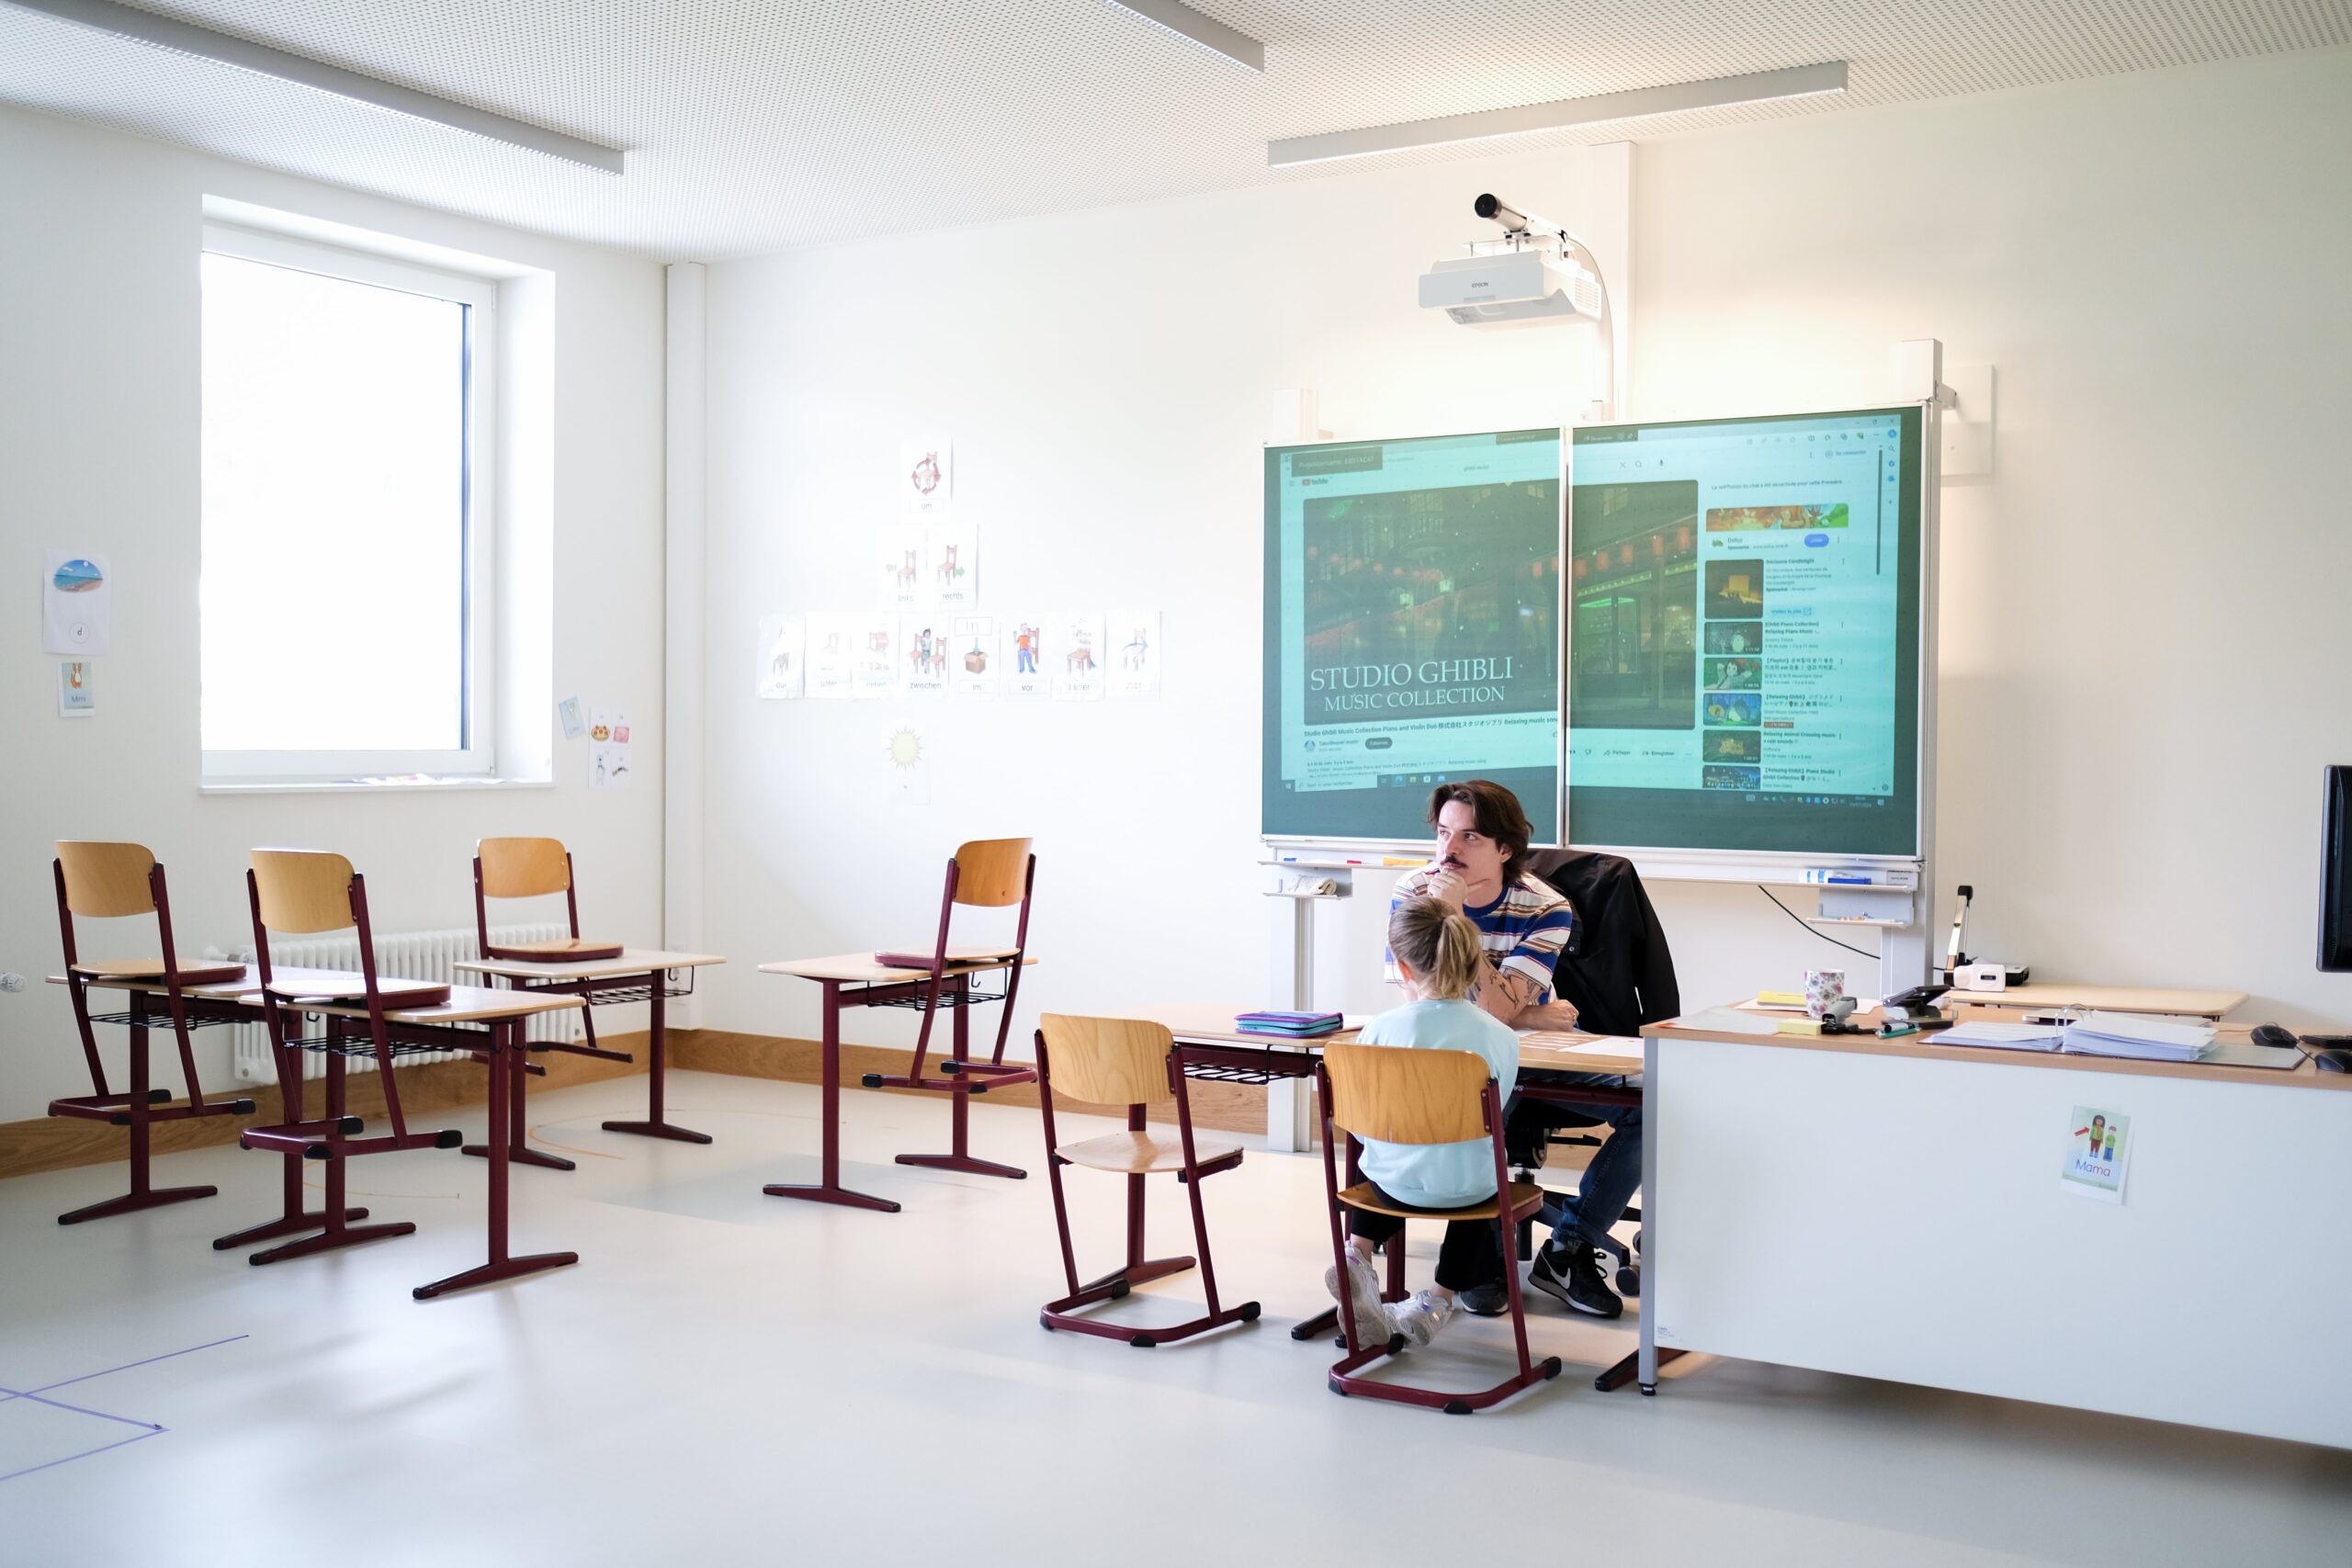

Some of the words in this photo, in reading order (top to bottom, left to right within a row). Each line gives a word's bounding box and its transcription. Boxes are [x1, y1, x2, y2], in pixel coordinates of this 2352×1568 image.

[942, 592, 964, 601] rechts
[77, 627, 83, 637] d
[1310, 662, 1412, 691] STUDIO
[1419, 656, 1513, 683] GHIBLI
[910, 682, 942, 690] zwischen
[1324, 693, 1383, 711] MUSIC
[1386, 686, 1505, 707] COLLECTION
[2075, 1158, 2111, 1177] Mama
